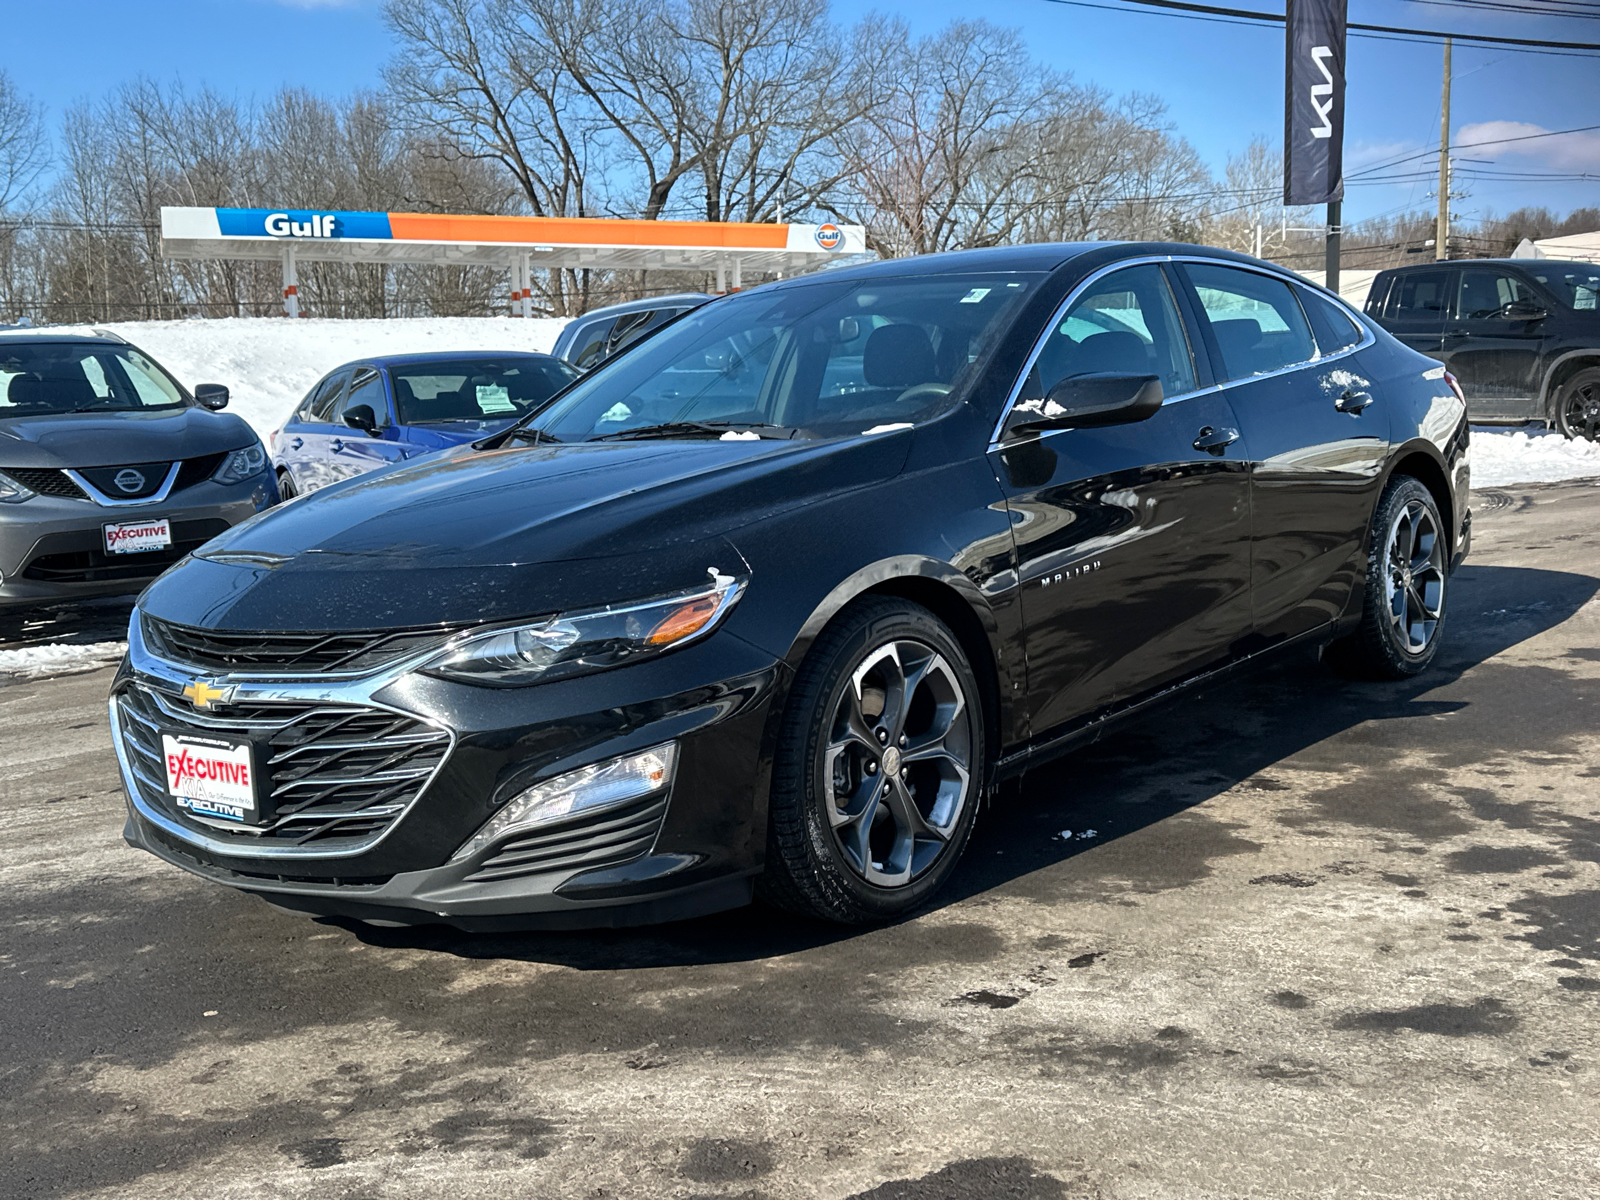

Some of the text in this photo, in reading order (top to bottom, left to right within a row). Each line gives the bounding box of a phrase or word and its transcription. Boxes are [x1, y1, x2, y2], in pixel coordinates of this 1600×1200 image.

[264, 213, 336, 237] Gulf
[817, 231, 839, 240] Gulf
[107, 526, 166, 546] EXECUTIVE
[1041, 561, 1101, 587] MALIBU
[168, 748, 249, 787] EXECUTIVE
[182, 777, 207, 800] KIA
[177, 797, 244, 818] EXECUTIVE
